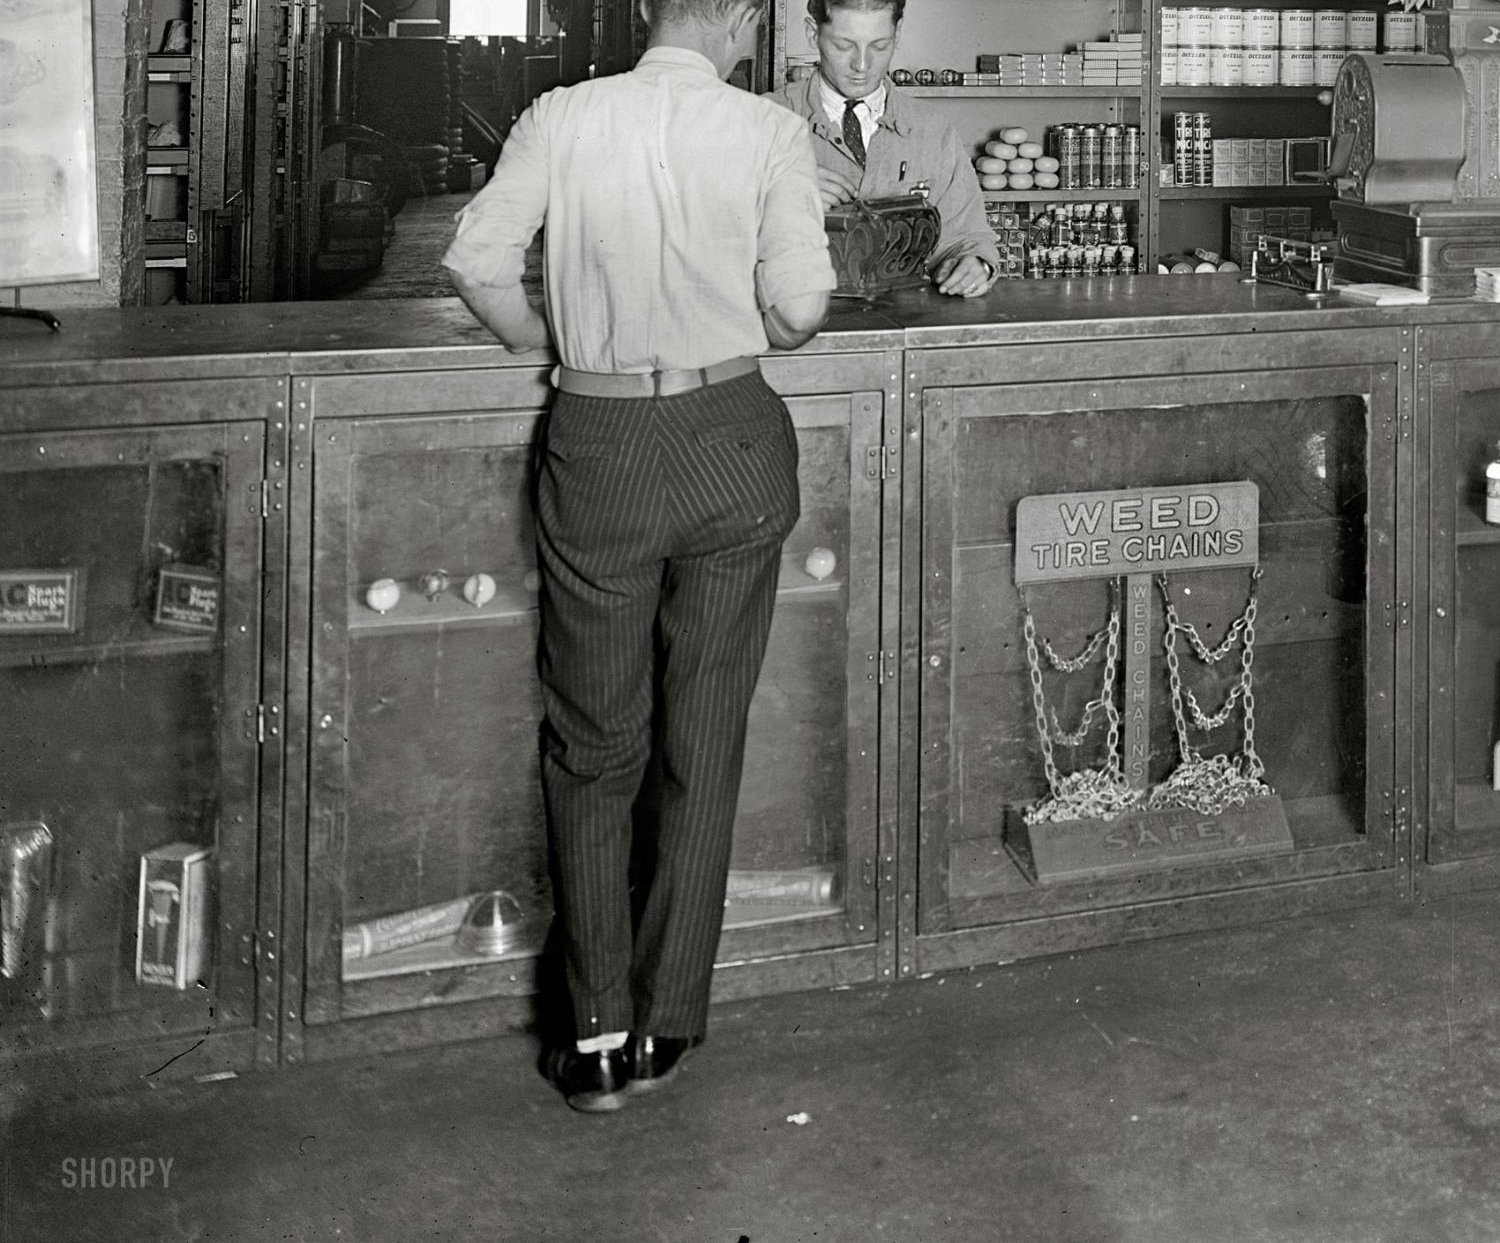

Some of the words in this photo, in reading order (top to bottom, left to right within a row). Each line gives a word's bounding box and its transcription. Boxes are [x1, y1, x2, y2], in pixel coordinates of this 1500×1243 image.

[1140, 161, 1149, 171] 50
[1058, 494, 1220, 536] WEED
[1031, 539, 1110, 569] TIRE
[1122, 529, 1243, 562] CHAINS
[27, 584, 65, 596] Spark
[27, 594, 65, 609] Plugs
[1105, 821, 1221, 851] SAFE
